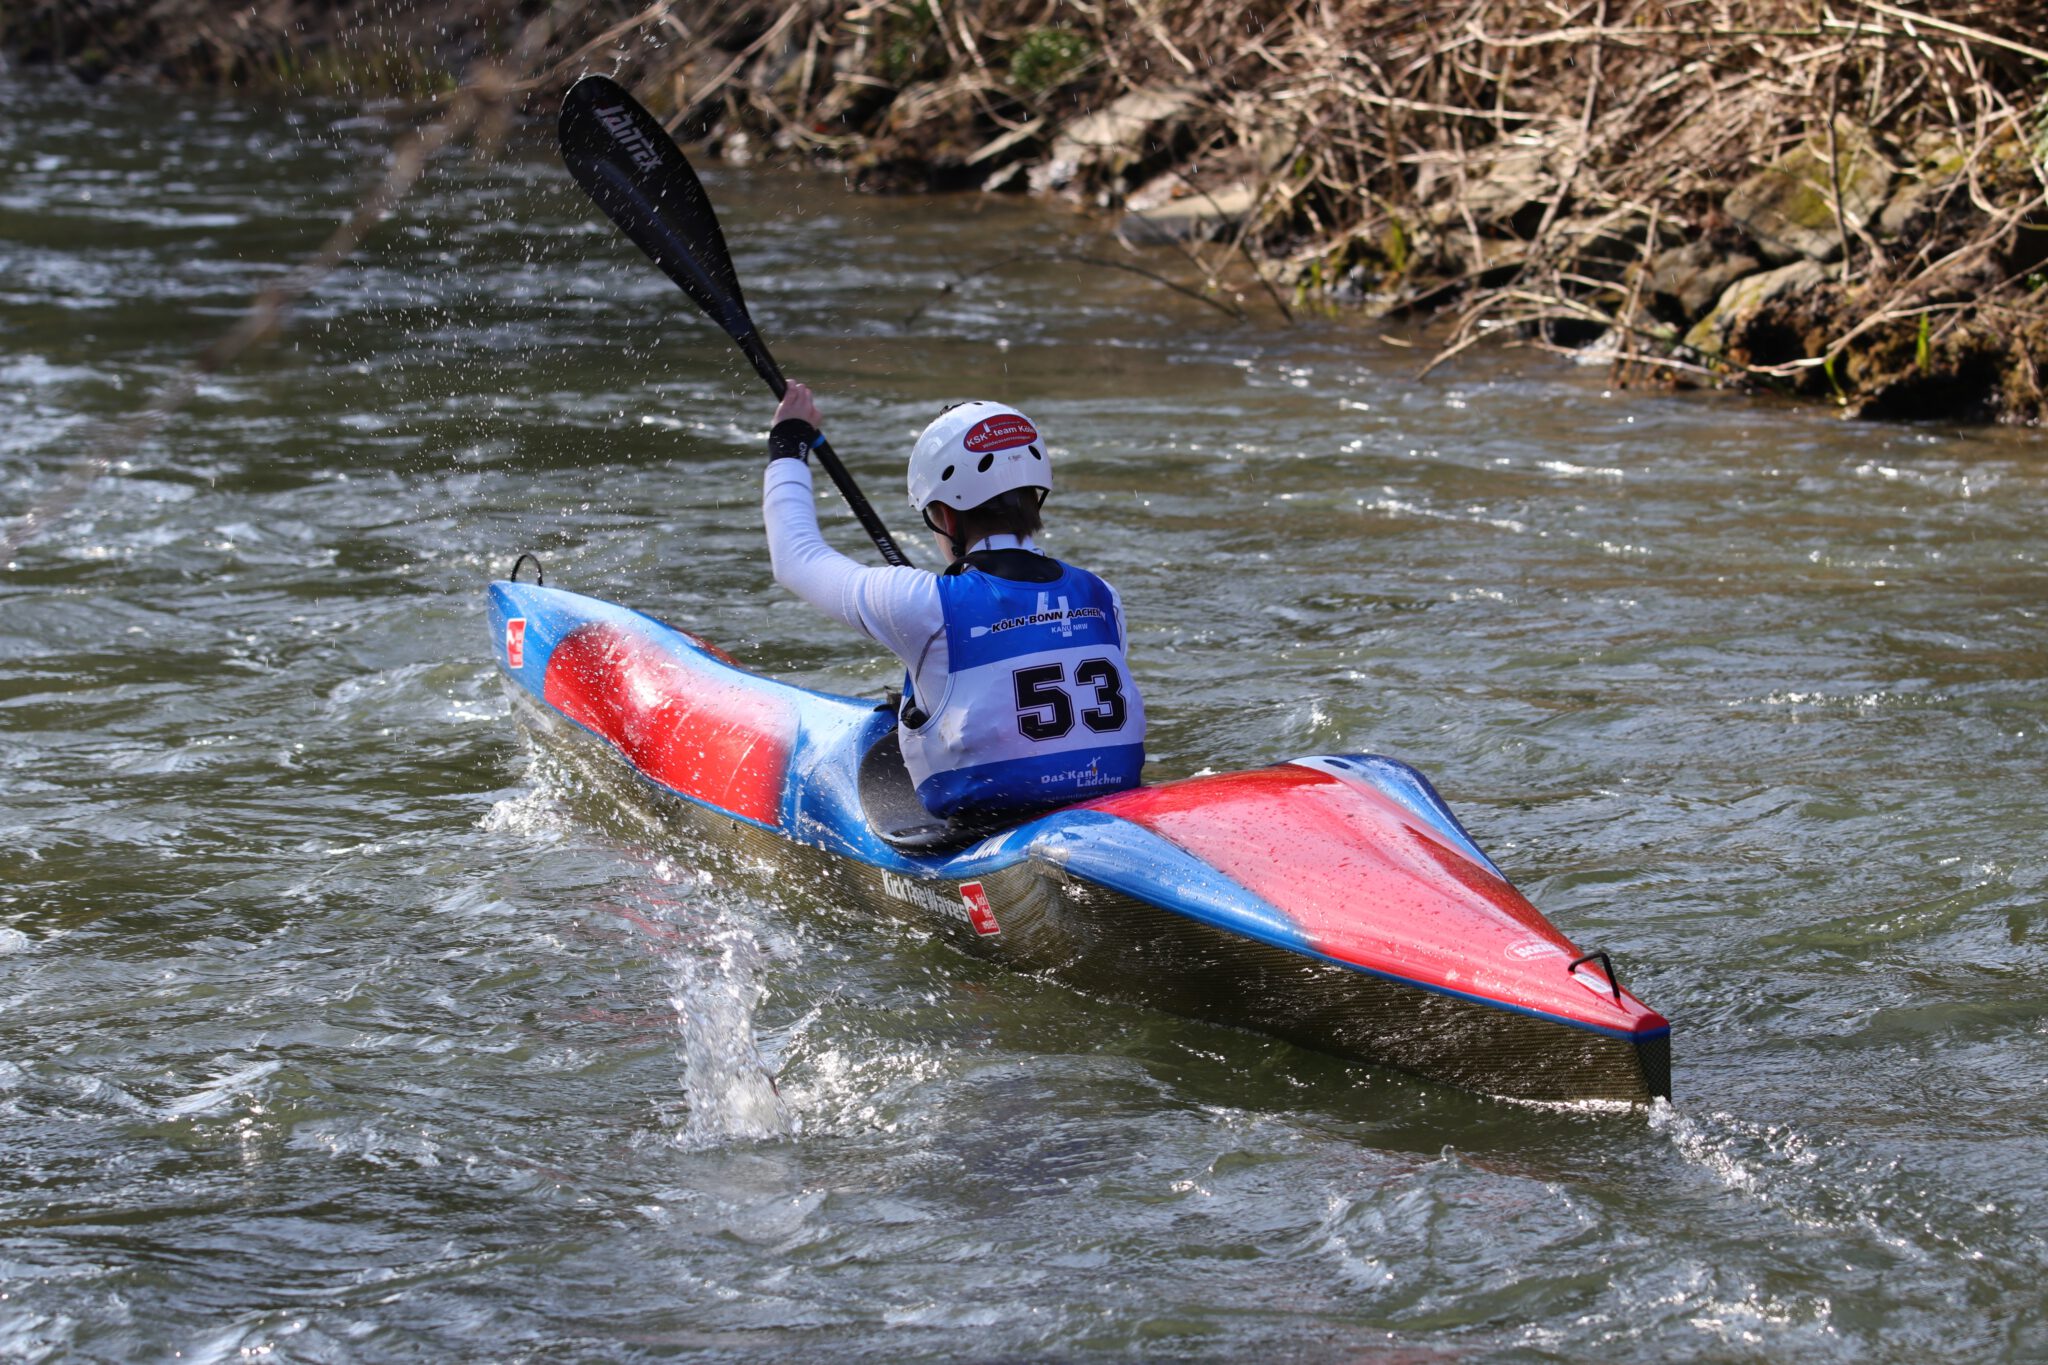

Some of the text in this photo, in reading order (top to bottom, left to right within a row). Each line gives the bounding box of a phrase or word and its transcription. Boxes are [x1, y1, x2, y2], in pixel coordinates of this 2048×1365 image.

[966, 432, 988, 447] KSK
[993, 426, 1017, 437] team
[1028, 610, 1063, 625] BONN
[1012, 657, 1127, 742] 53
[1041, 774, 1064, 784] Das
